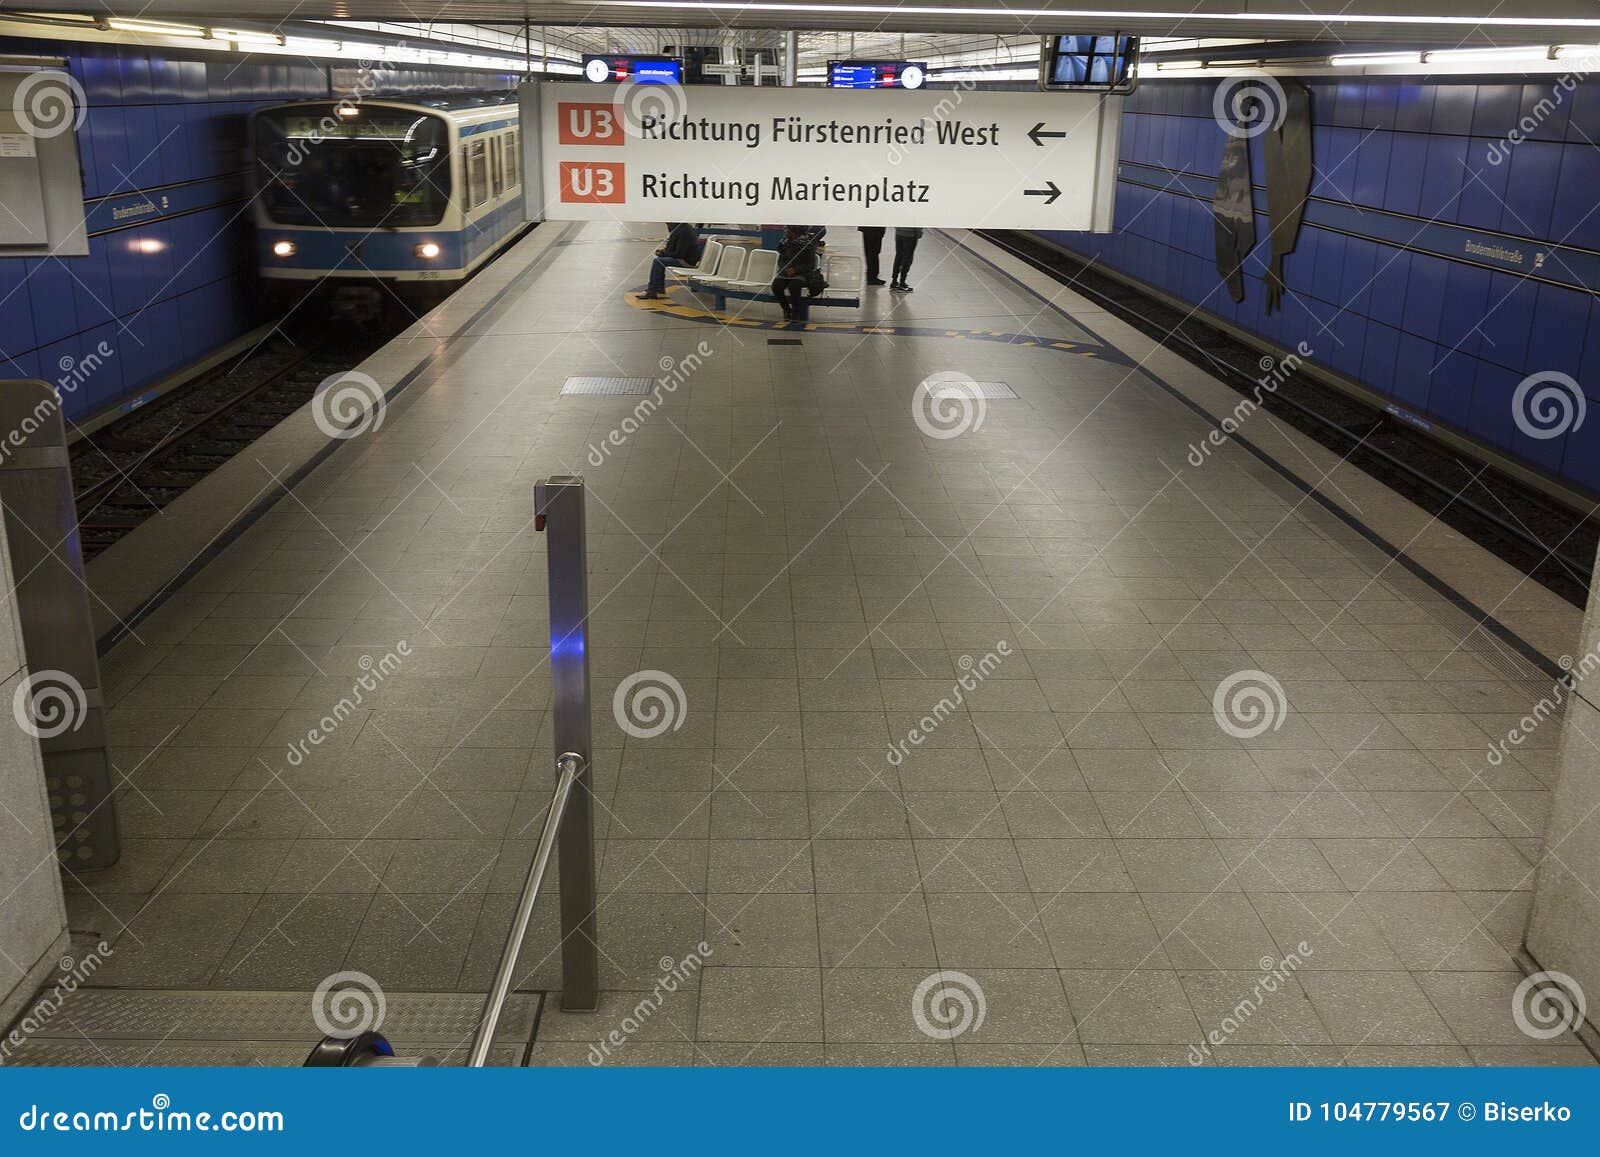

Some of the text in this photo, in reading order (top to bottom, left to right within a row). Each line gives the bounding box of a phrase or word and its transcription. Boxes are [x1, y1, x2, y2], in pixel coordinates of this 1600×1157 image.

[570, 109, 1000, 148] U3 Richtung Fürstenried West
[571, 168, 929, 208] U3 Richtung Marienplatz
